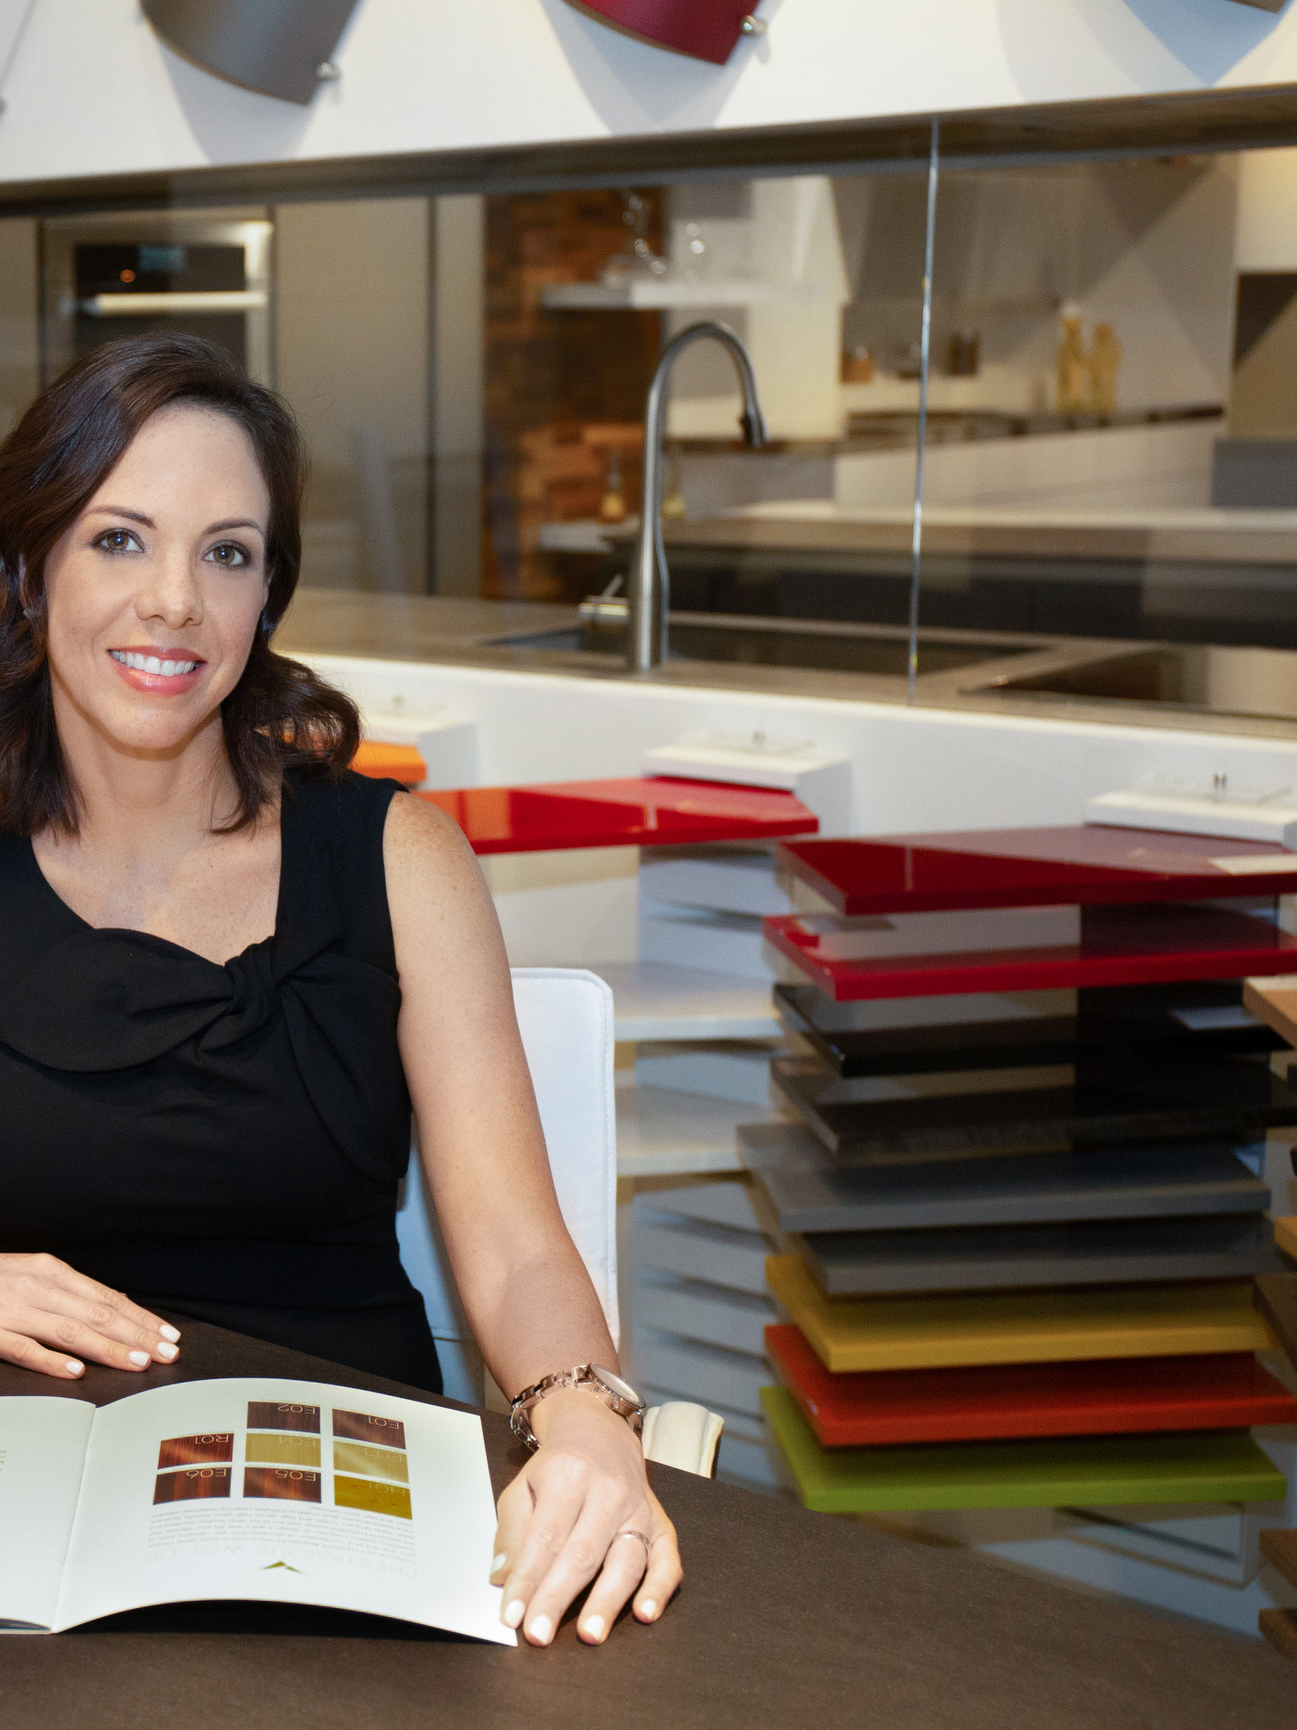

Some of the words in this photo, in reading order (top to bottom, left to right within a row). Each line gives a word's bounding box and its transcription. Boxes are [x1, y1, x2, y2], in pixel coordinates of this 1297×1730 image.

[278, 1403, 316, 1415] E02
[367, 1416, 400, 1430] E01
[195, 1434, 229, 1445] R01
[186, 1468, 227, 1480] E06
[275, 1469, 317, 1482] E05
